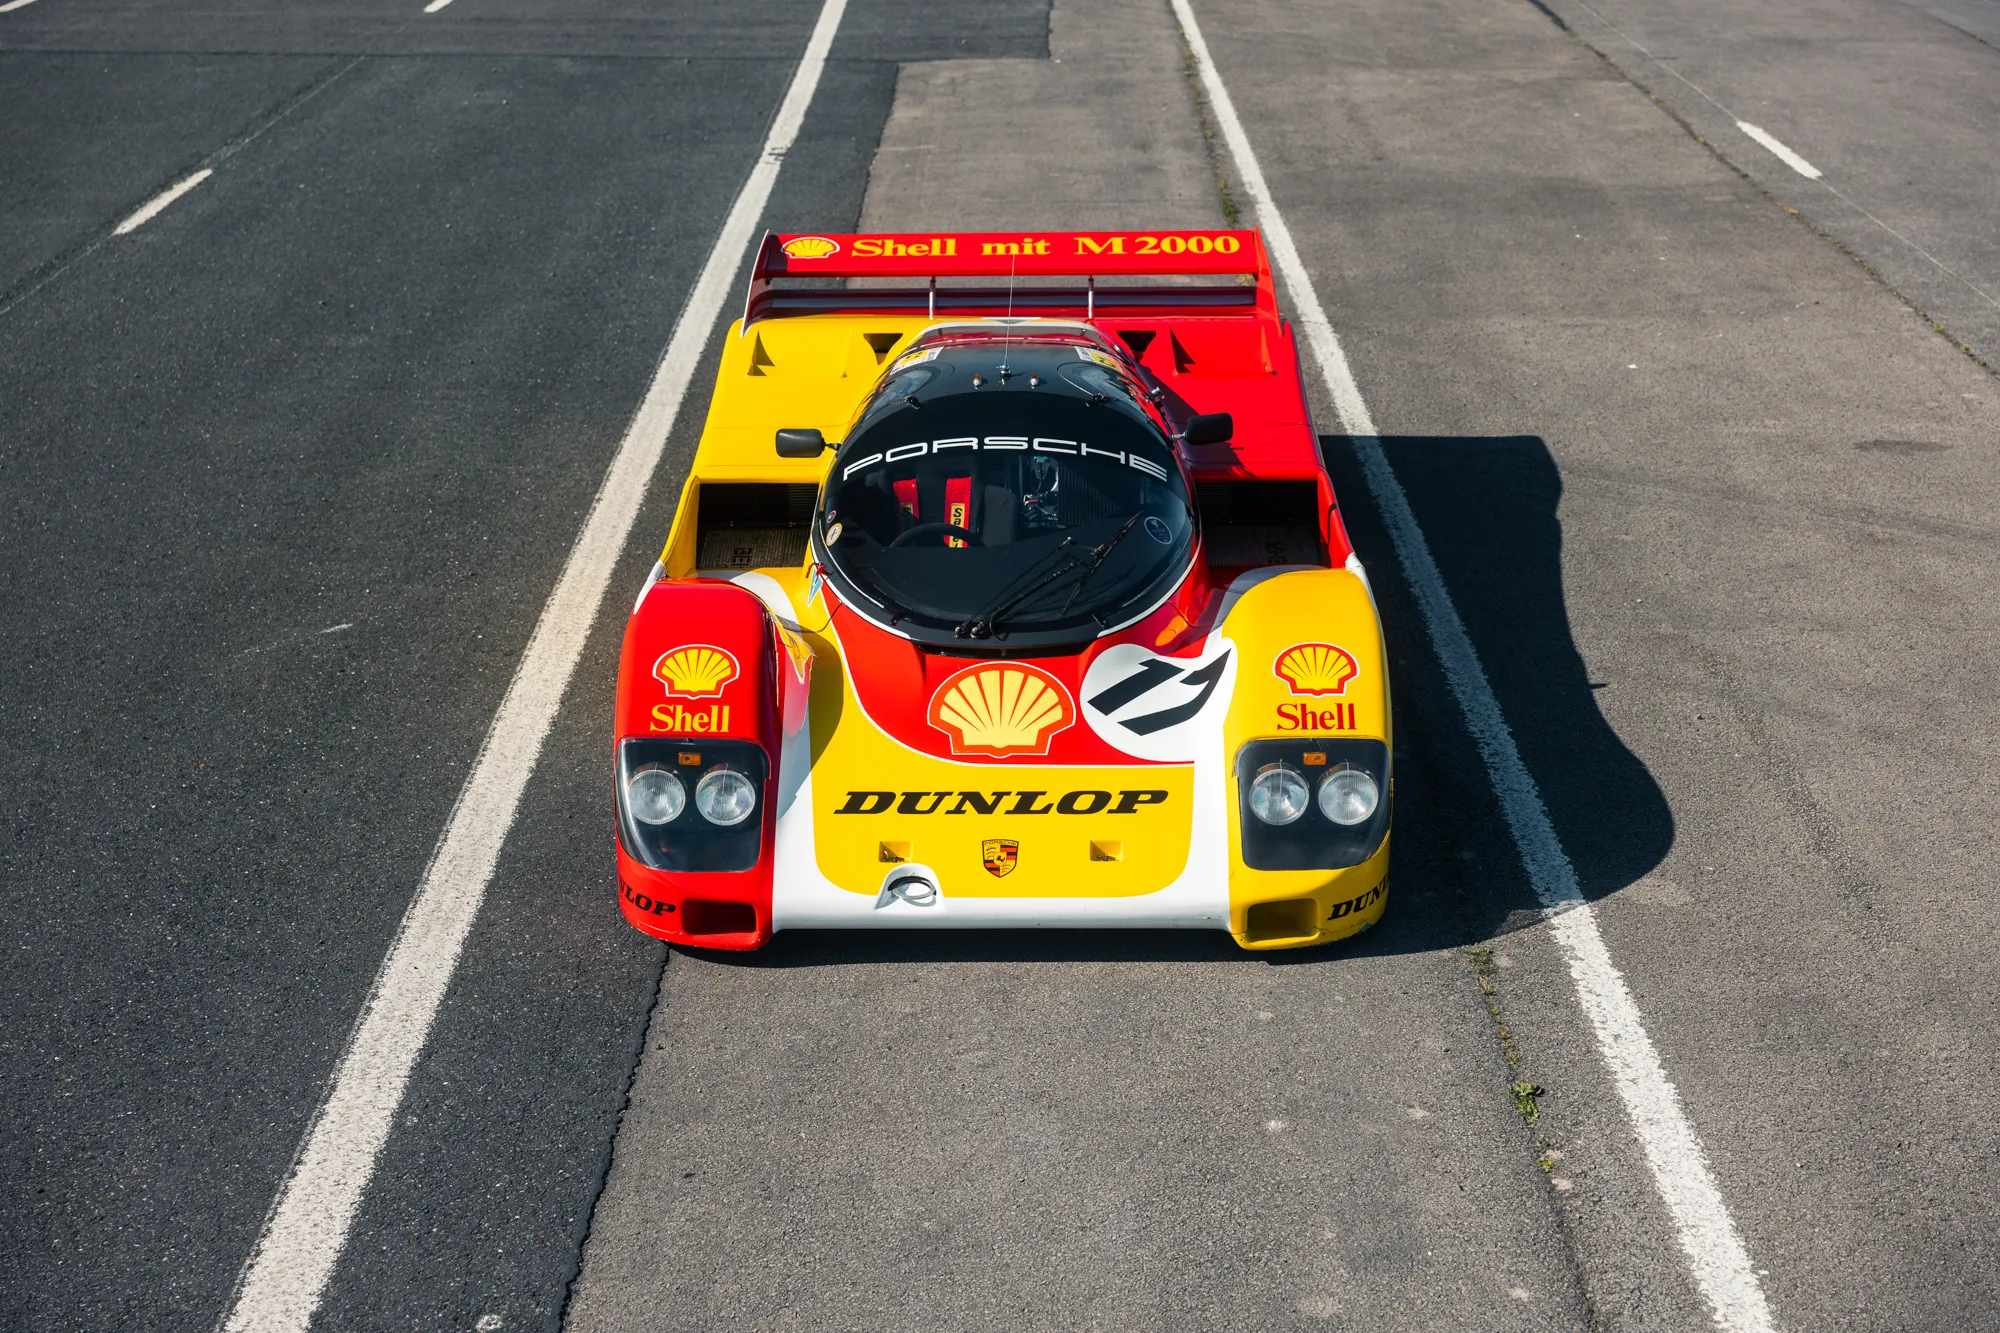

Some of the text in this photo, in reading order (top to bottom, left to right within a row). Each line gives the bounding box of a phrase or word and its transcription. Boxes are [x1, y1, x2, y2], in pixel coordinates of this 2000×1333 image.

[852, 235, 1241, 257] Shell mit M 2000
[842, 436, 1168, 483] PORSCHE
[1086, 648, 1232, 737] 17
[649, 703, 731, 733] Shell
[1276, 702, 1358, 731] Shell
[833, 789, 1169, 816] DUNLOP
